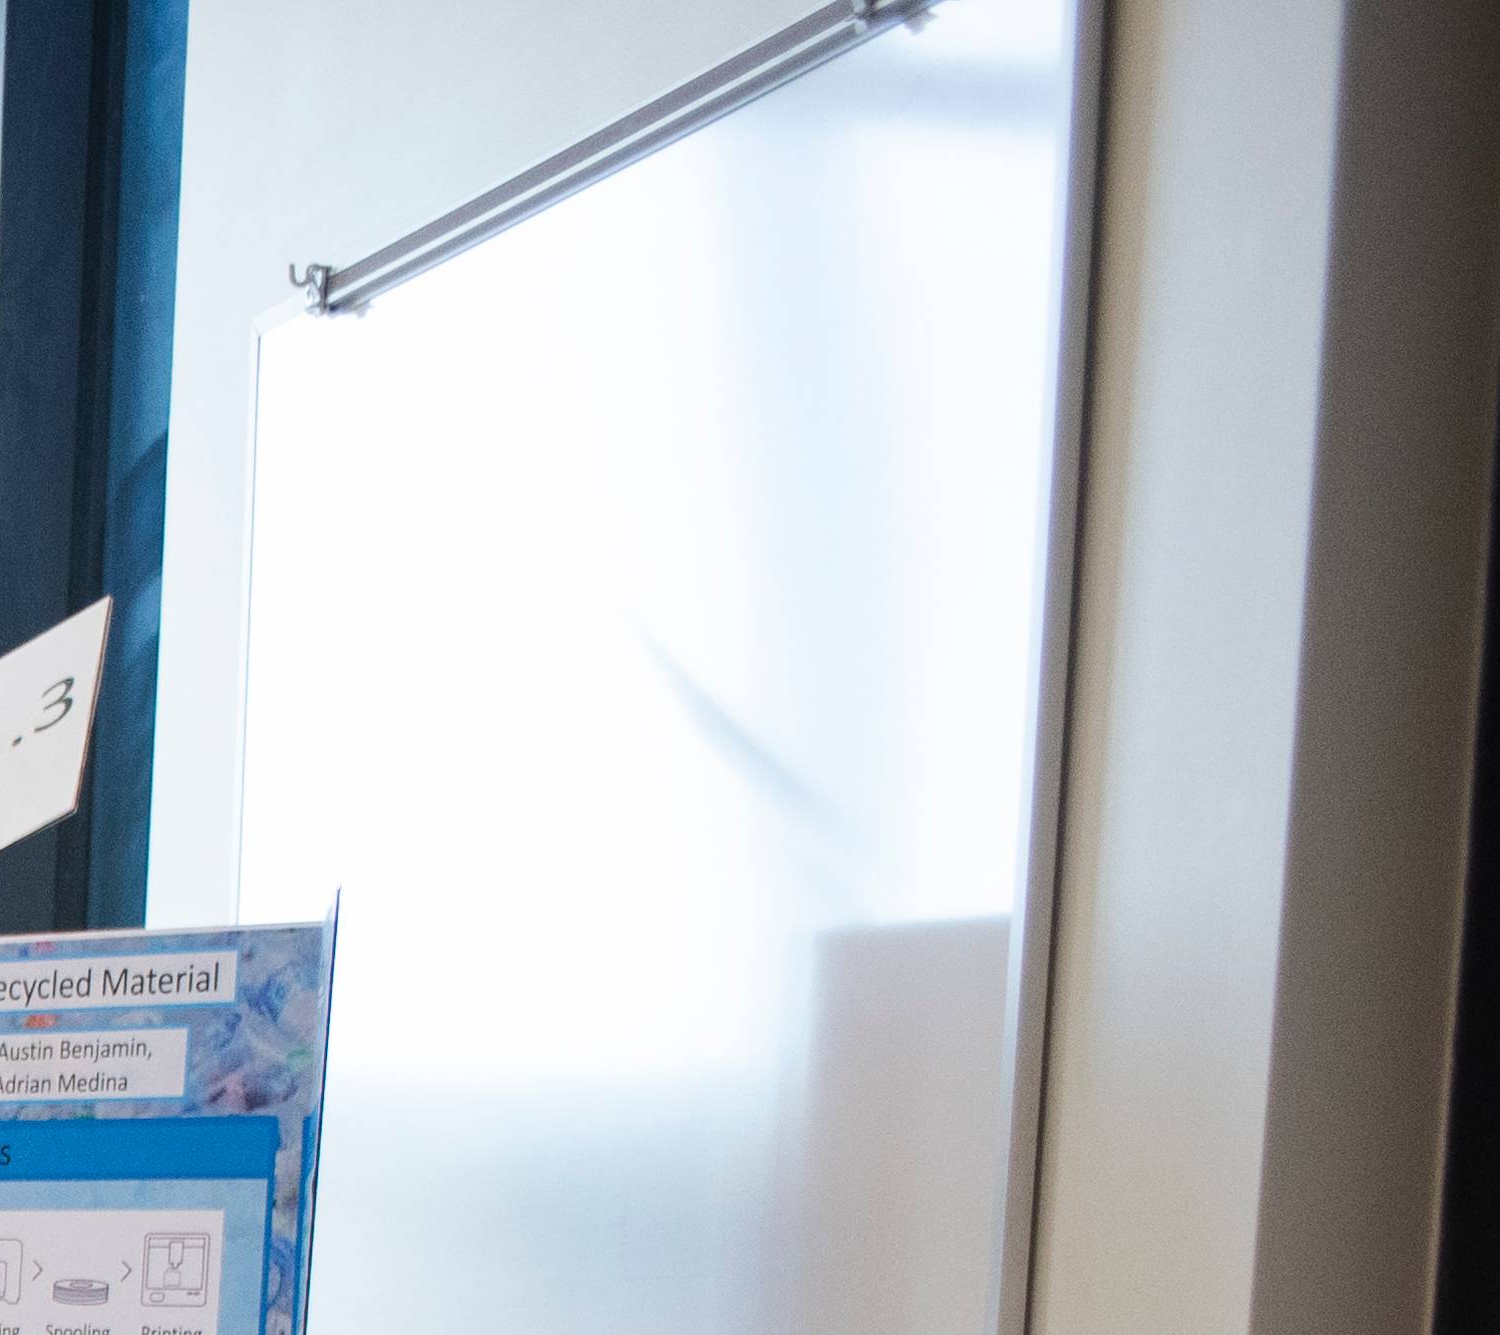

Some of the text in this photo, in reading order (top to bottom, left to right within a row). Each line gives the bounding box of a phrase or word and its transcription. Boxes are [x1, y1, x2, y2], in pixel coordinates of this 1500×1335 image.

[102, 962, 219, 996] Material
[60, 1039, 152, 1063] Benjamin,
[58, 1072, 128, 1092] Medina
